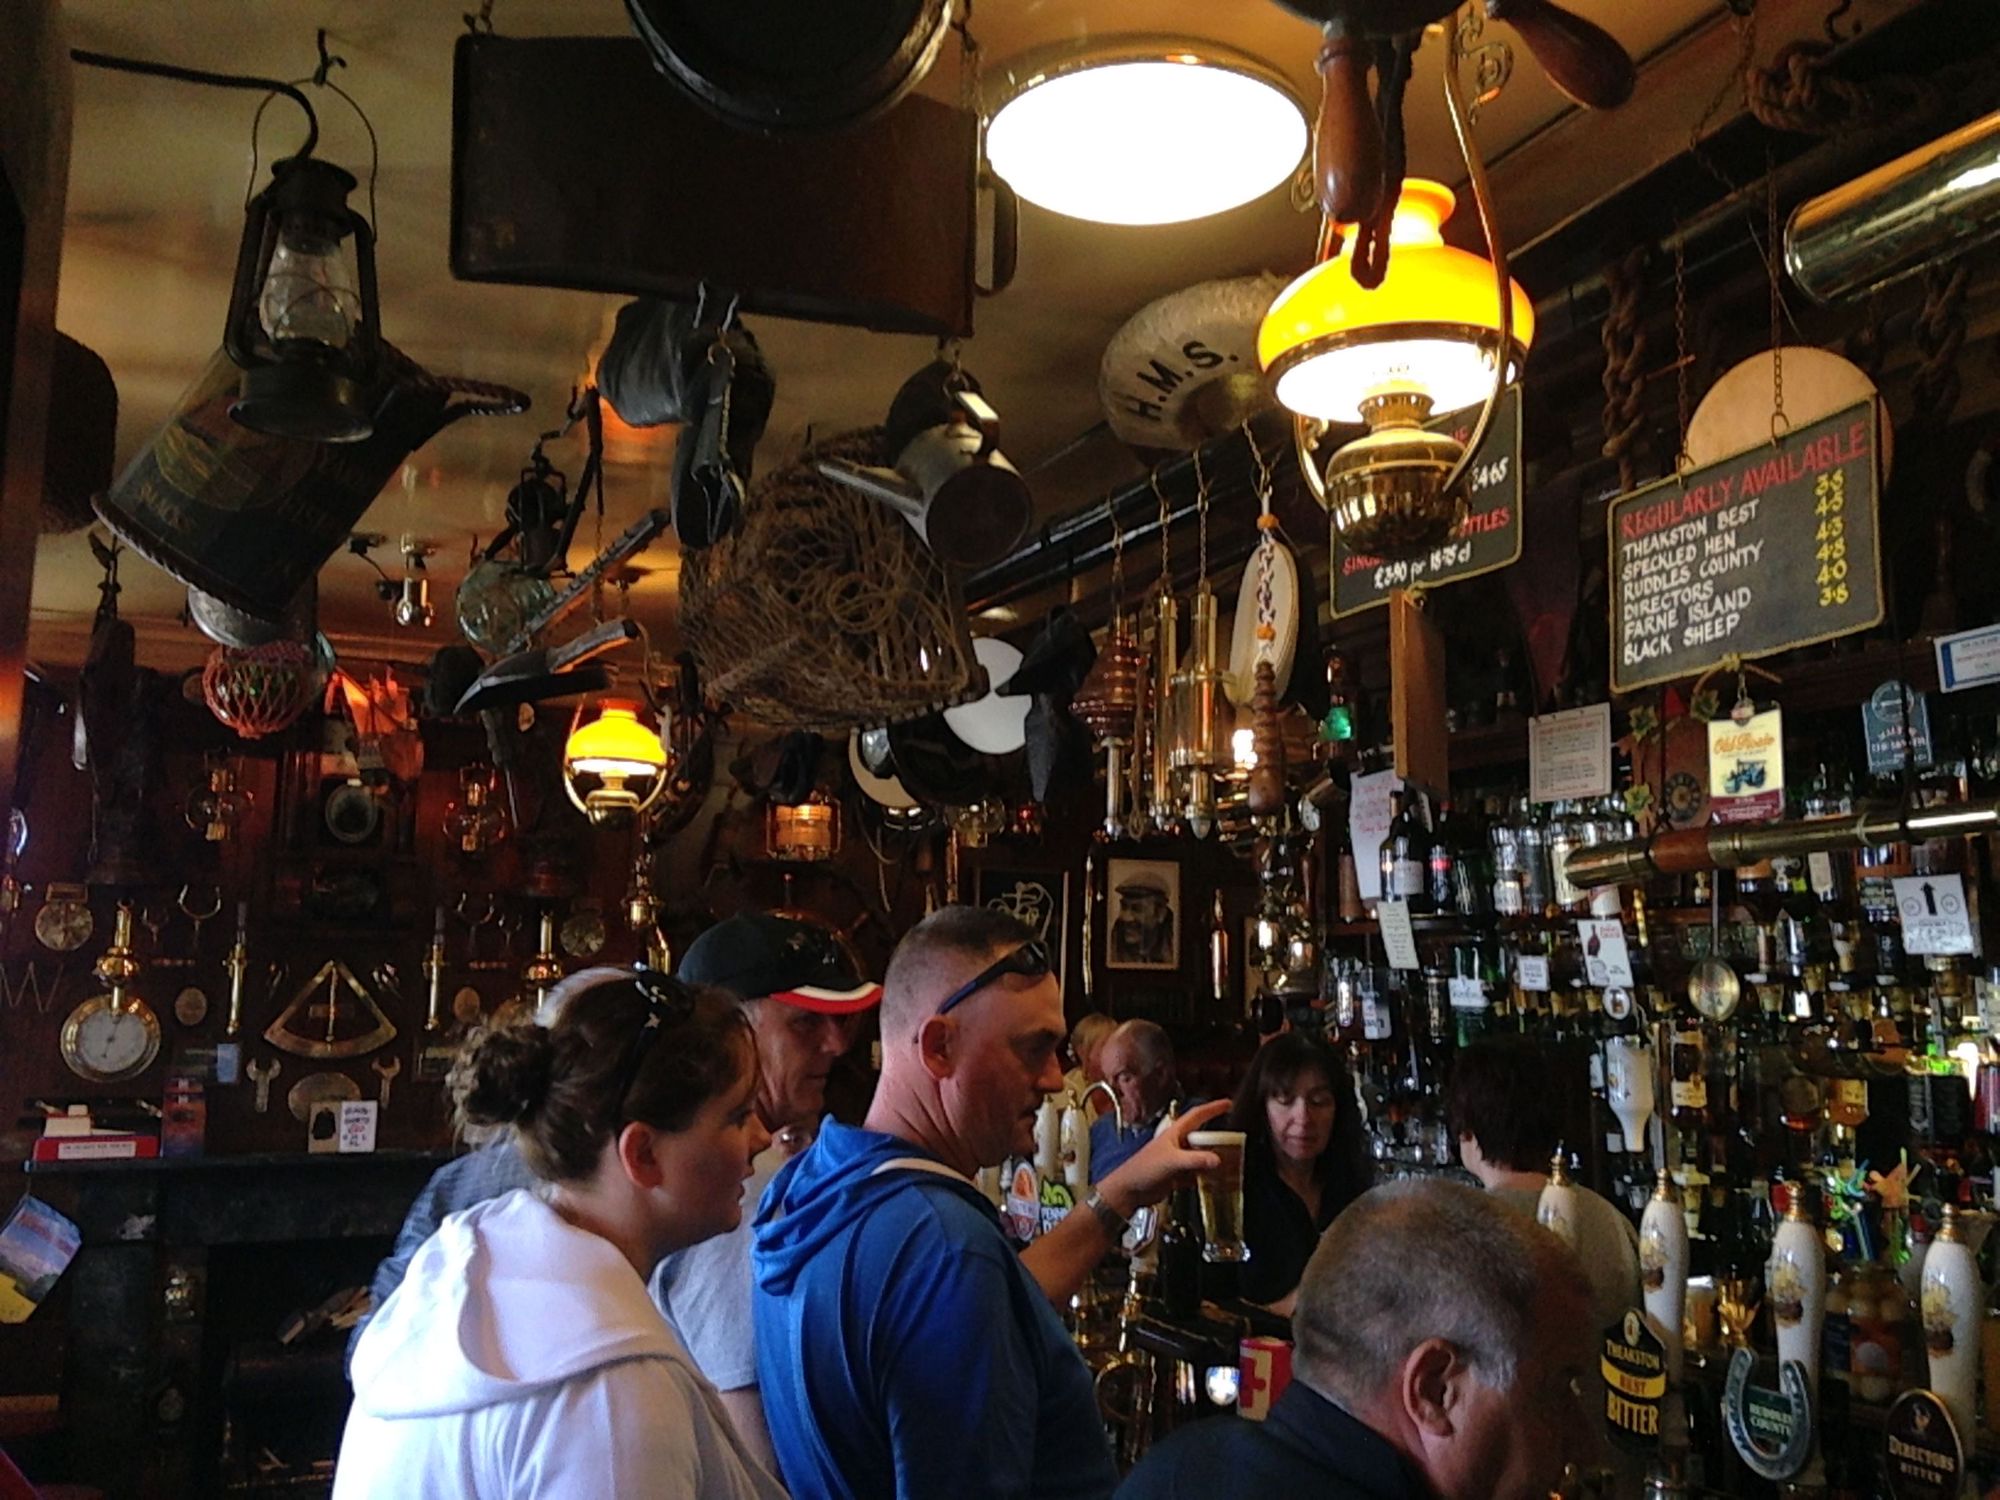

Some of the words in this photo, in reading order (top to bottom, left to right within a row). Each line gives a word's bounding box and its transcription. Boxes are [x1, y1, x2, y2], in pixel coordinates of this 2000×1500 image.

[1622, 477, 1734, 537] REGULARLY
[1742, 423, 1867, 491] AVAILABLE
[1622, 517, 1708, 561] THEAKSTON
[1717, 498, 1760, 529] BEST
[1622, 541, 1698, 583] SPECKLED
[1704, 528, 1737, 555] HEN
[1623, 562, 1692, 601] RUDDLES
[1699, 539, 1764, 579] COUNTY
[1623, 580, 1714, 621] DIRECTORS
[1624, 606, 1679, 643] FARNE
[1688, 586, 1752, 623] ISLAND
[1623, 635, 1673, 666] BLACK
[1683, 614, 1741, 647] SHEEP
[1605, 1337, 1661, 1371] THEAKSTON
[1619, 1374, 1647, 1395] BEST
[1606, 1388, 1660, 1436] BITTER
[1889, 1435, 1955, 1473] DIRECTORS
